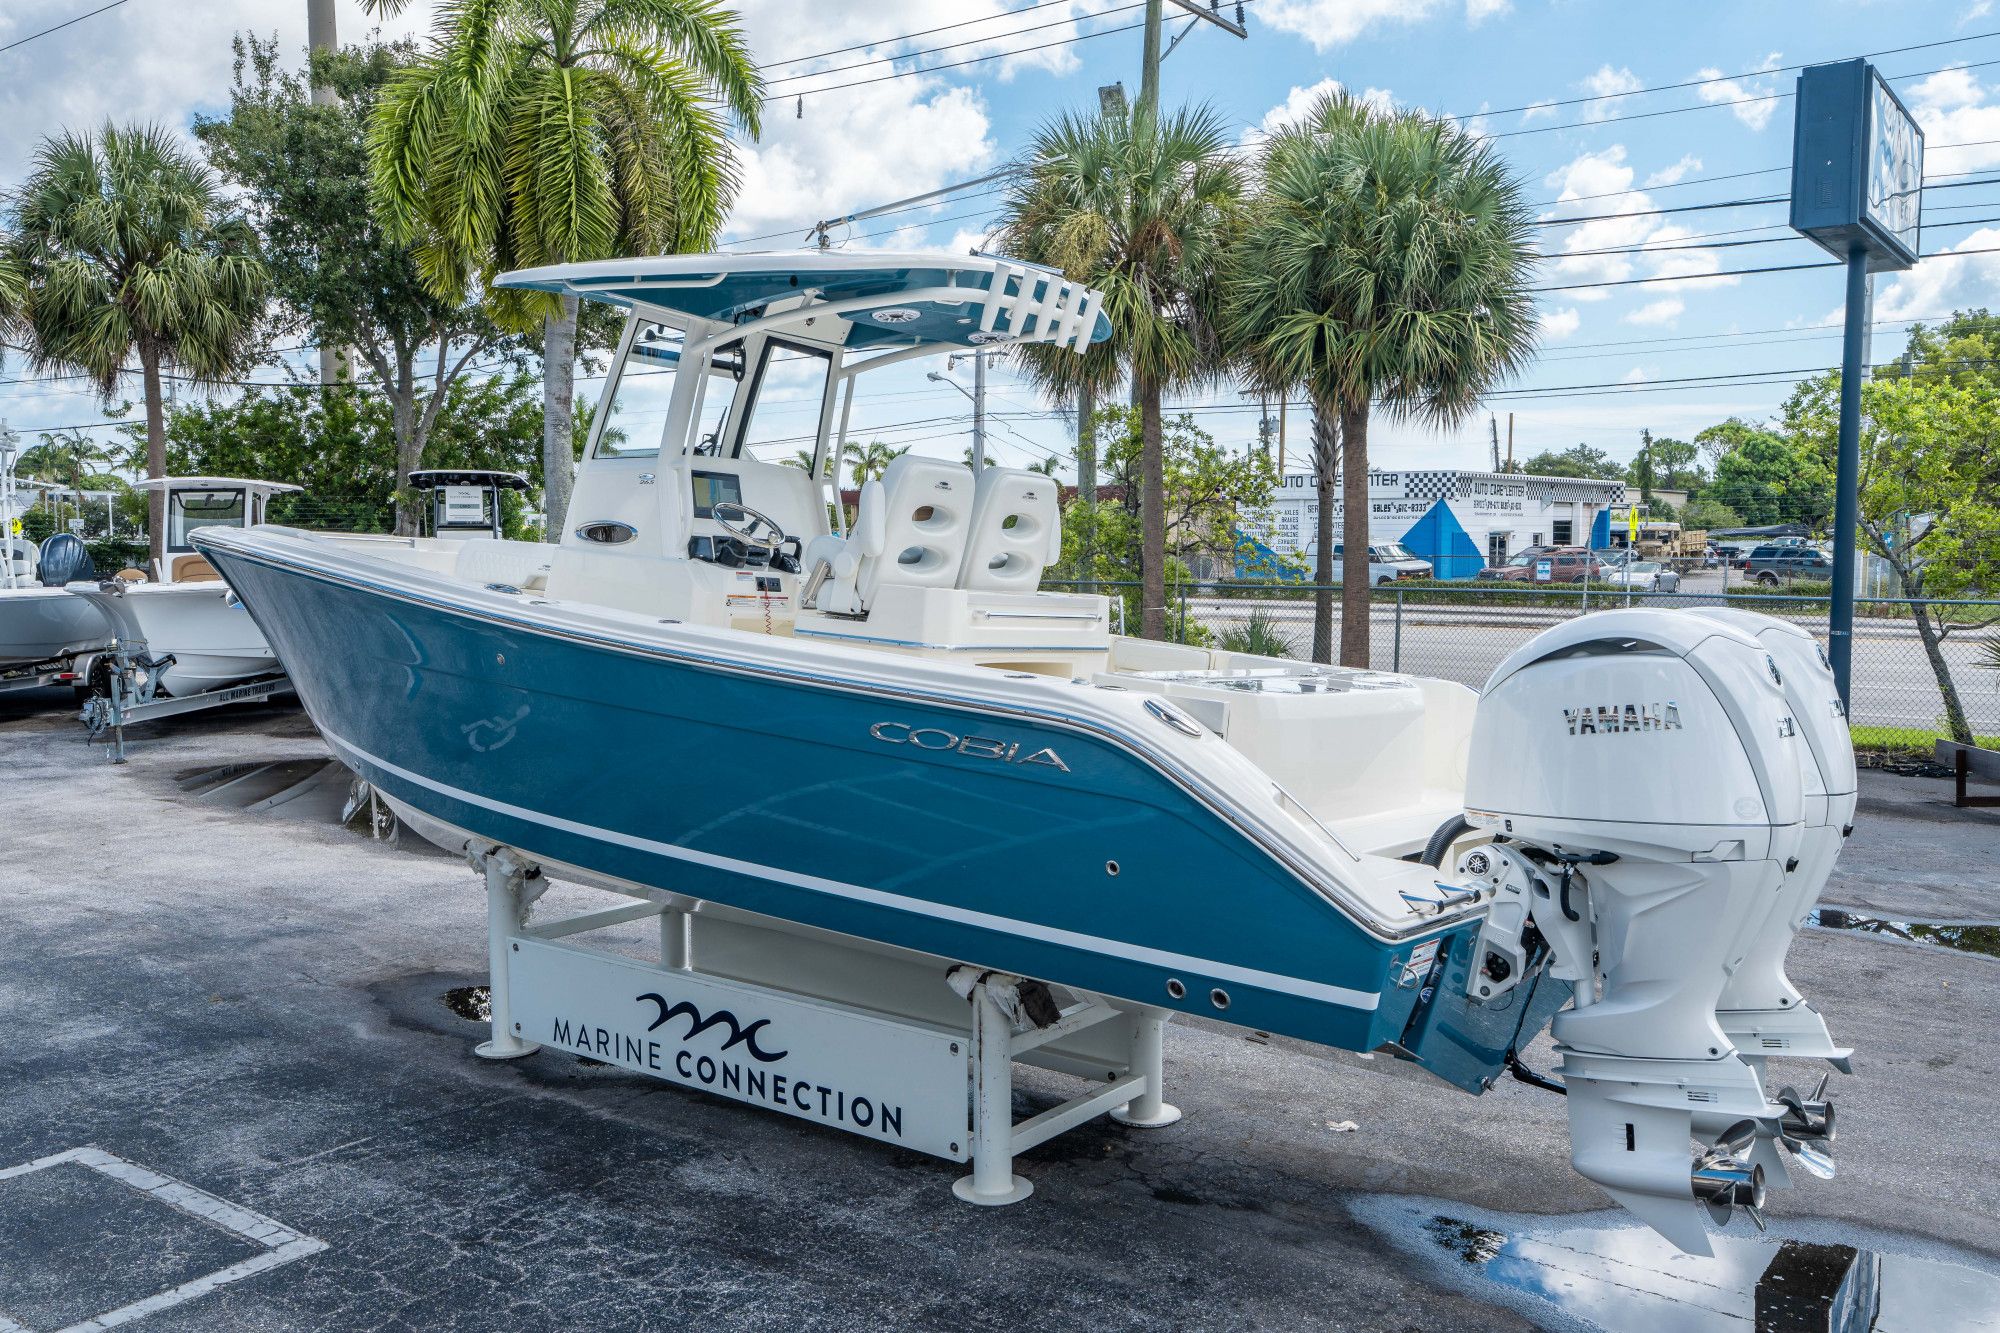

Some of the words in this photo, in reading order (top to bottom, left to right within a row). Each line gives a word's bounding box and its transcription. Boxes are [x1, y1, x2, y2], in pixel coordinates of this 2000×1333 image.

[1278, 475, 1304, 488] UTO
[1475, 482, 1488, 495] AUTO
[1491, 483, 1503, 496] CARE
[1505, 485, 1524, 497] CENTER
[219, 693, 229, 702] ALL
[230, 688, 251, 700] MARINE
[1563, 701, 1683, 735] YAMAHA
[869, 720, 1071, 773] COBIA
[553, 1016, 661, 1071] MARINE
[676, 1050, 902, 1137] CONNECTION
